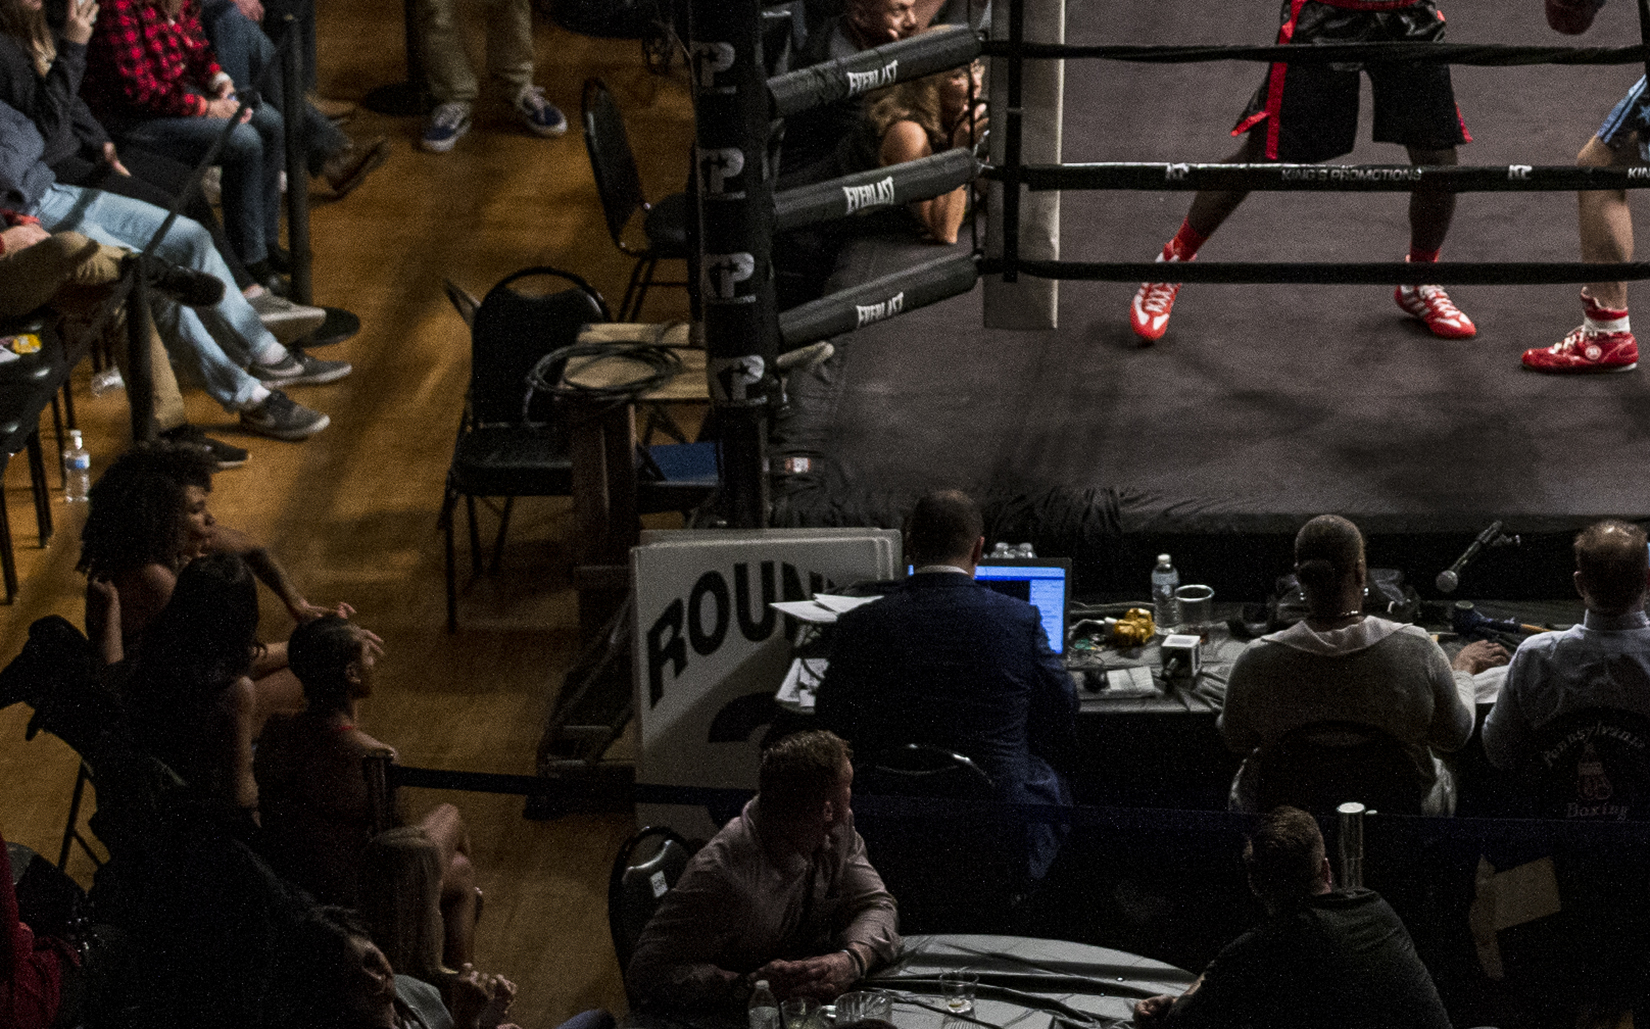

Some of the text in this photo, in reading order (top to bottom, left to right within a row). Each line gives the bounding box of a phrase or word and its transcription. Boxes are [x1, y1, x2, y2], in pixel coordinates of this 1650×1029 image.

[846, 58, 899, 95] EVERLAST
[1330, 167, 1423, 182] PROMOTIONS
[842, 175, 896, 216] EVERLAST
[855, 291, 905, 329] EVERLAST
[1566, 800, 1630, 824] Boxing
